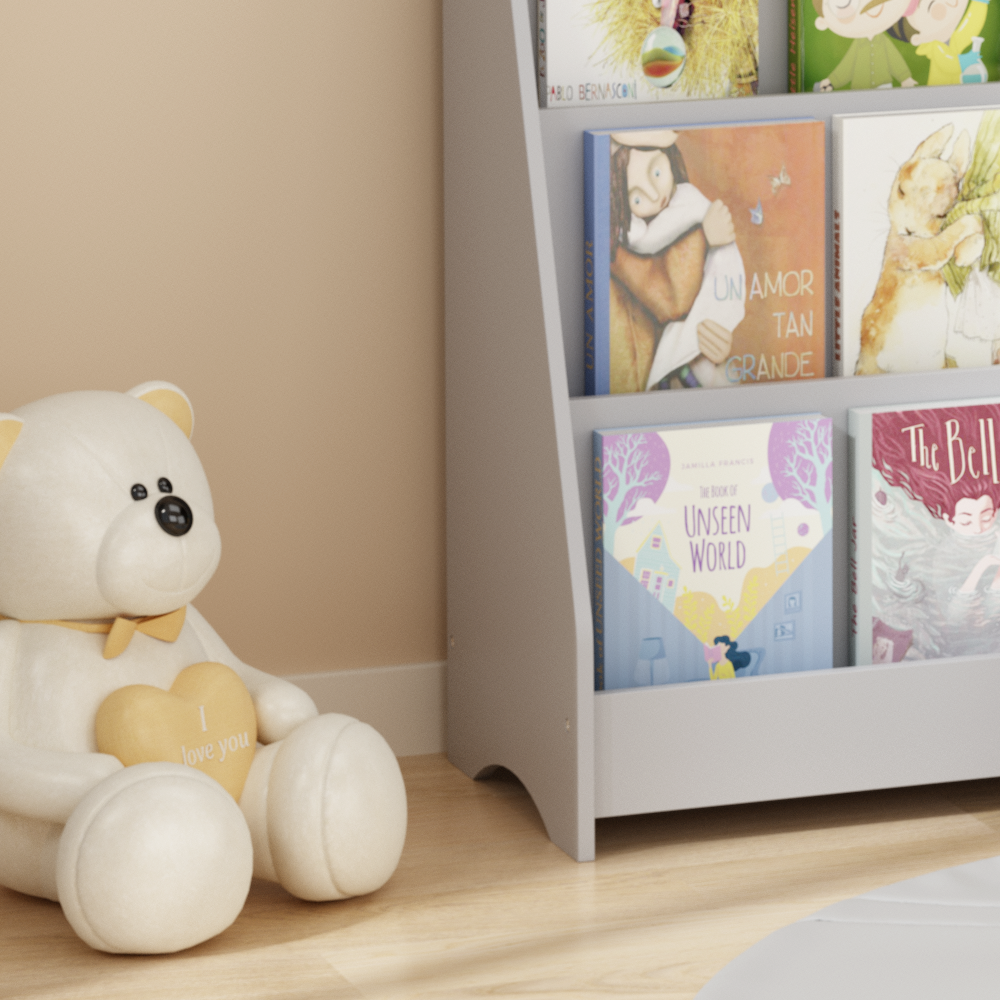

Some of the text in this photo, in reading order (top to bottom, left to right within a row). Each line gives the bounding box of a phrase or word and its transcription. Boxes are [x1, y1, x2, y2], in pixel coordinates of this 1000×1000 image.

[578, 80, 638, 101] BERNASCONI
[714, 269, 814, 301] UN AMOR
[585, 240, 594, 370] UN AMOR
[772, 310, 814, 338] TAN
[724, 351, 815, 384] GRANDE
[901, 423, 938, 472] The
[945, 418, 1000, 484] Bell
[700, 484, 738, 498] THE BOOK OF
[684, 504, 751, 538] UNSEEN
[690, 538, 746, 574] WORLD
[198, 705, 208, 732] I
[181, 732, 250, 766] love you
